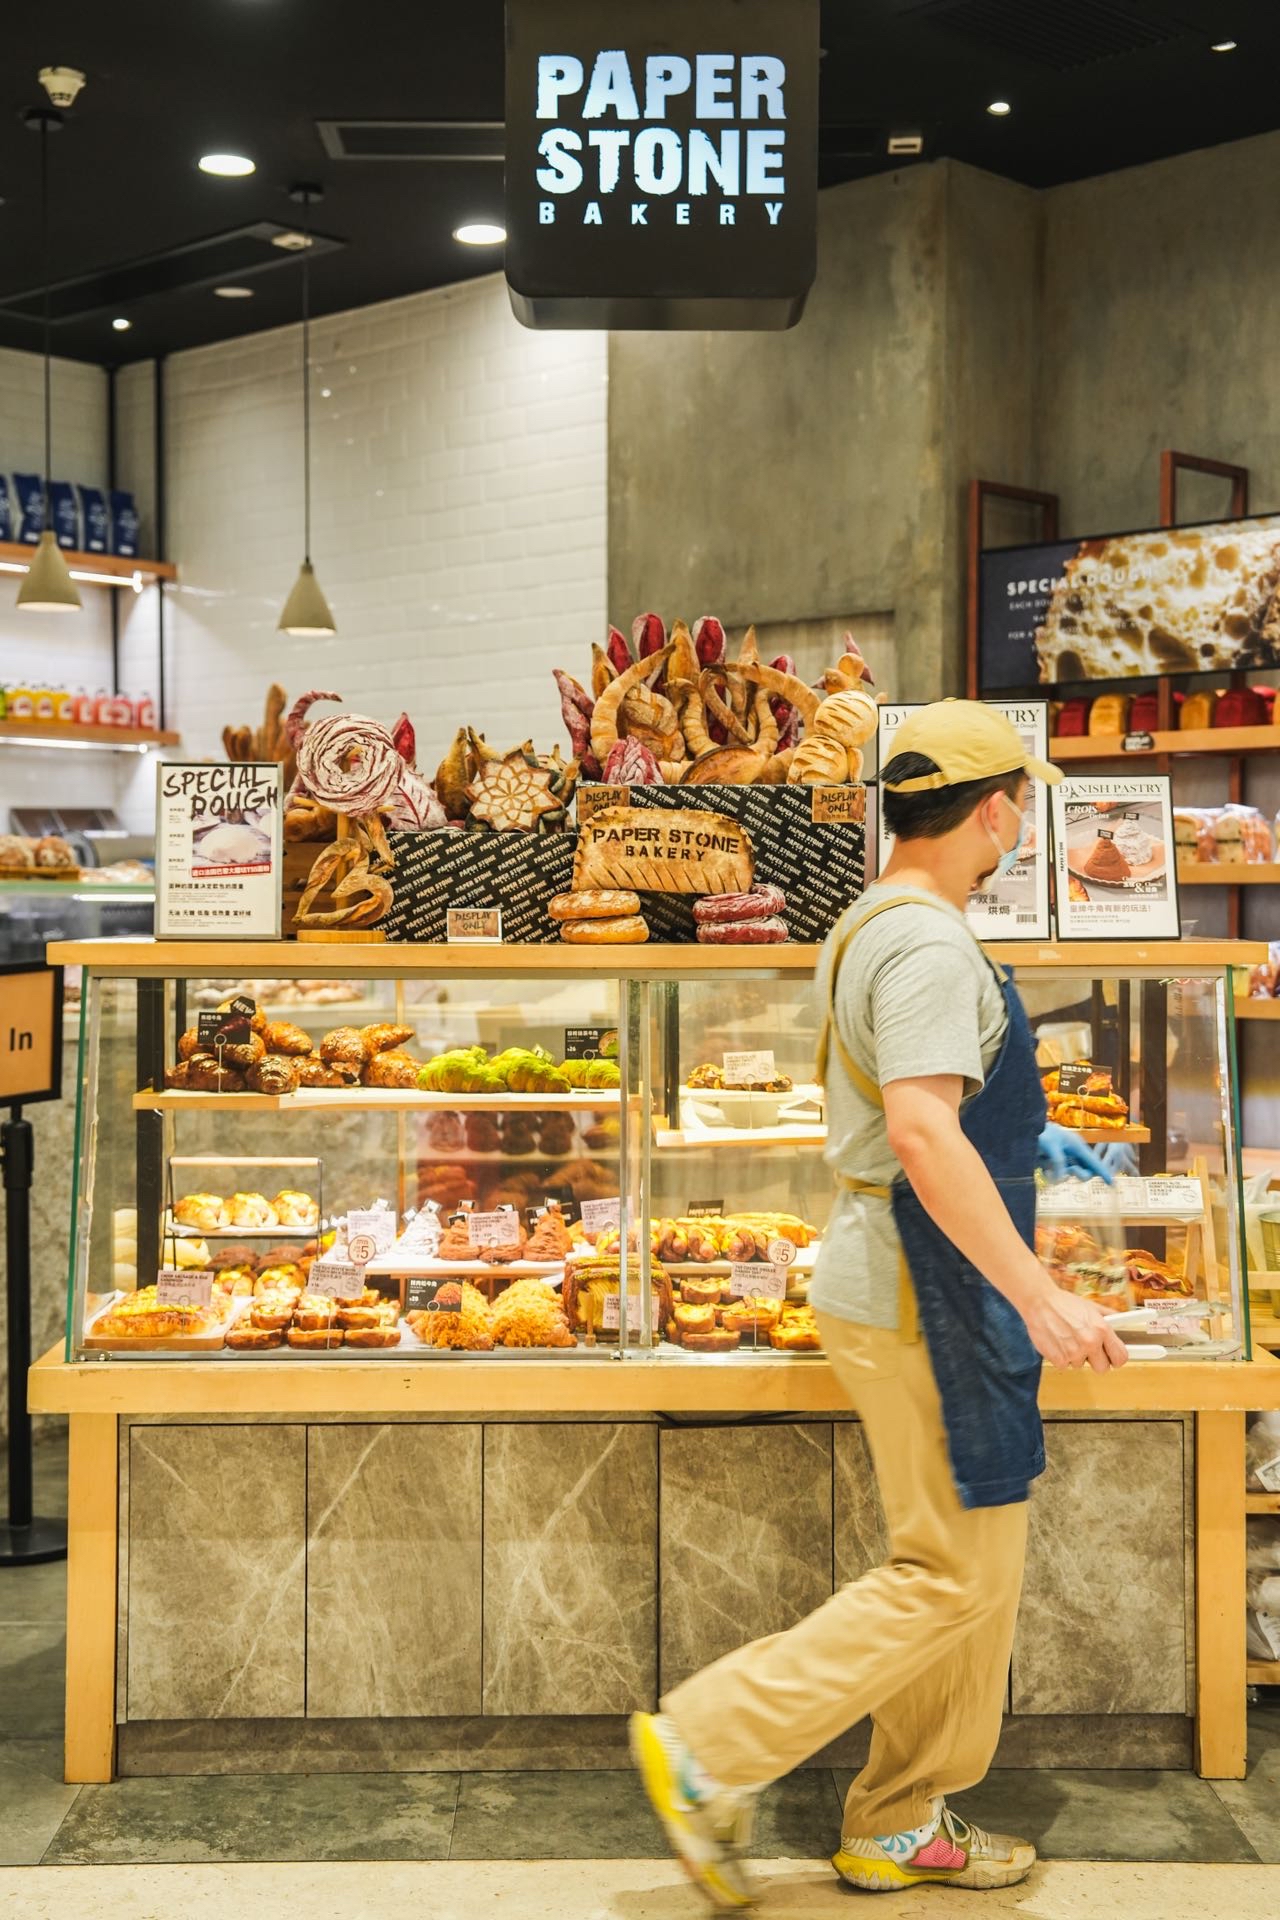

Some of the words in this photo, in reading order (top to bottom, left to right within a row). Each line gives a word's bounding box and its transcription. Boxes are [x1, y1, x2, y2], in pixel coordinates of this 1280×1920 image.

[536, 50, 787, 120] PAPER
[536, 127, 786, 196] STONE
[539, 201, 783, 225] BAKERY
[1007, 576, 1079, 596] SPECIAL
[163, 766, 271, 797] SPECIAL
[586, 791, 622, 803] DISPLAY
[820, 791, 857, 804] DISPLAY
[1059, 783, 1112, 797] DANISH
[1113, 783, 1163, 794] PASTRY
[190, 786, 278, 822] DOUGH
[828, 802, 852, 813] ONLY
[1067, 805, 1098, 814] CROIS
[592, 828, 660, 843] PAPER
[669, 829, 739, 854] STONE
[625, 845, 705, 861] BAKERY
[1135, 882, 1145, 893] &
[455, 911, 491, 921] DISPLAY
[463, 920, 487, 930] ONLY
[233, 1000, 255, 1014] NEW
[9, 1027, 33, 1052] In
